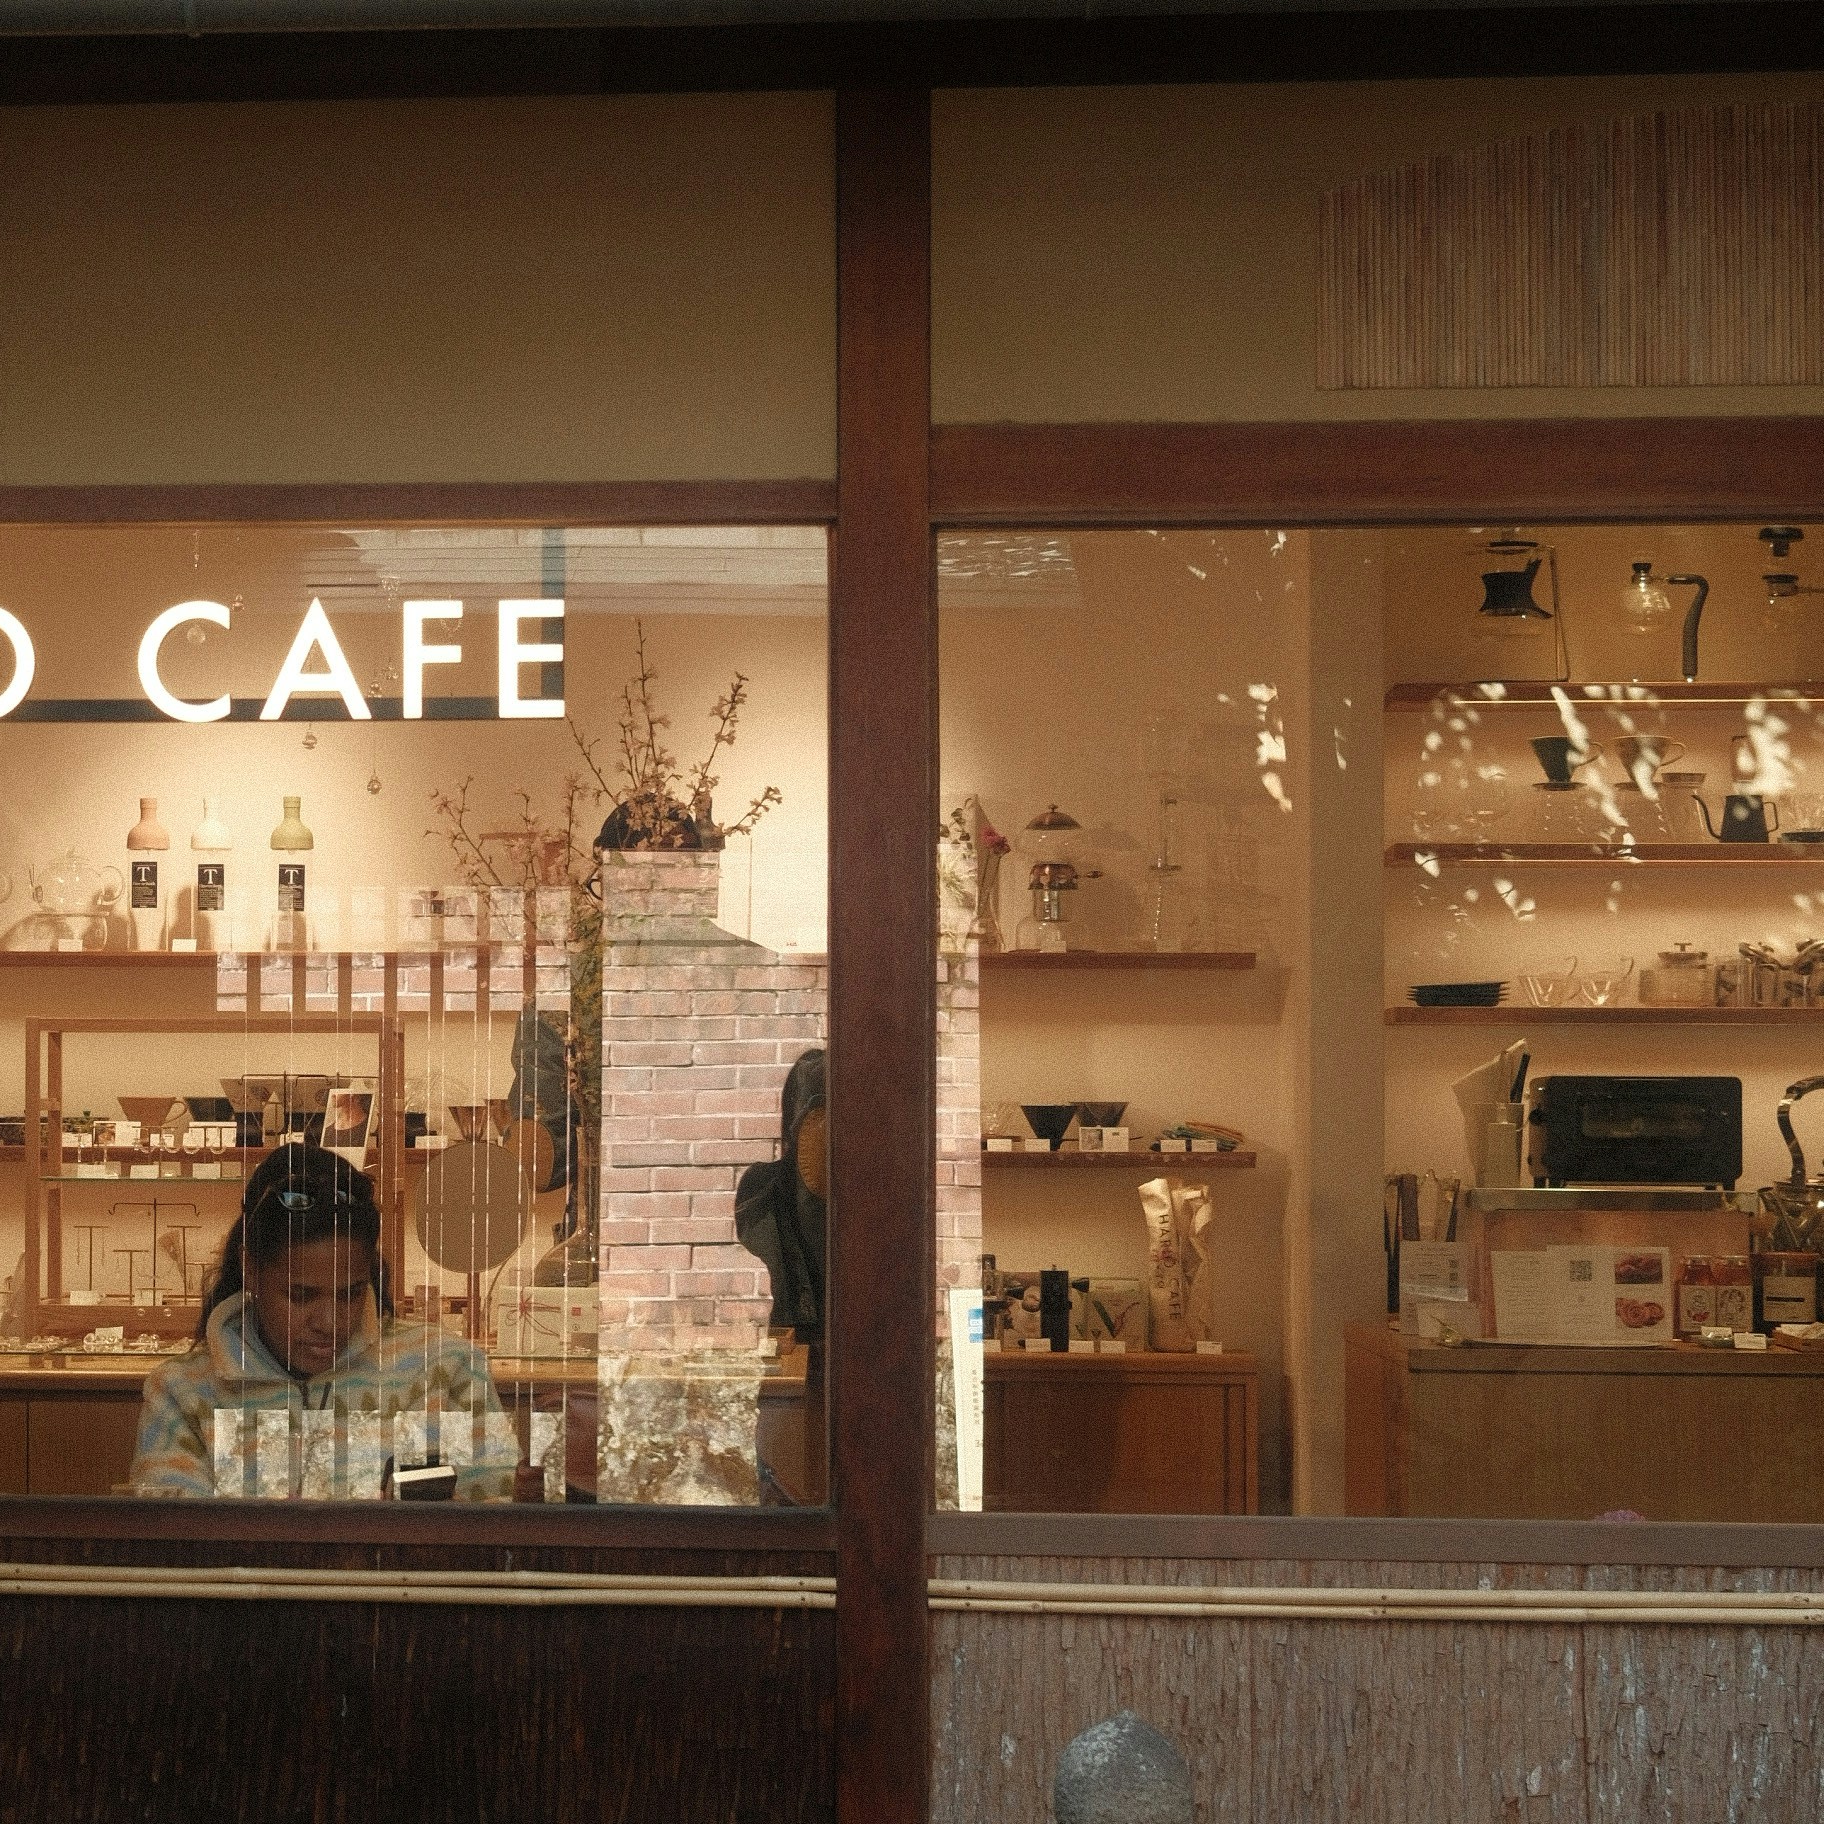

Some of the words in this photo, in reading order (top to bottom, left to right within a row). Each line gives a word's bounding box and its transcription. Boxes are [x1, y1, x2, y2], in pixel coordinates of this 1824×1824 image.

[136, 597, 567, 723] CAFE
[137, 866, 151, 882] T
[203, 869, 218, 885] T
[284, 869, 299, 886] T
